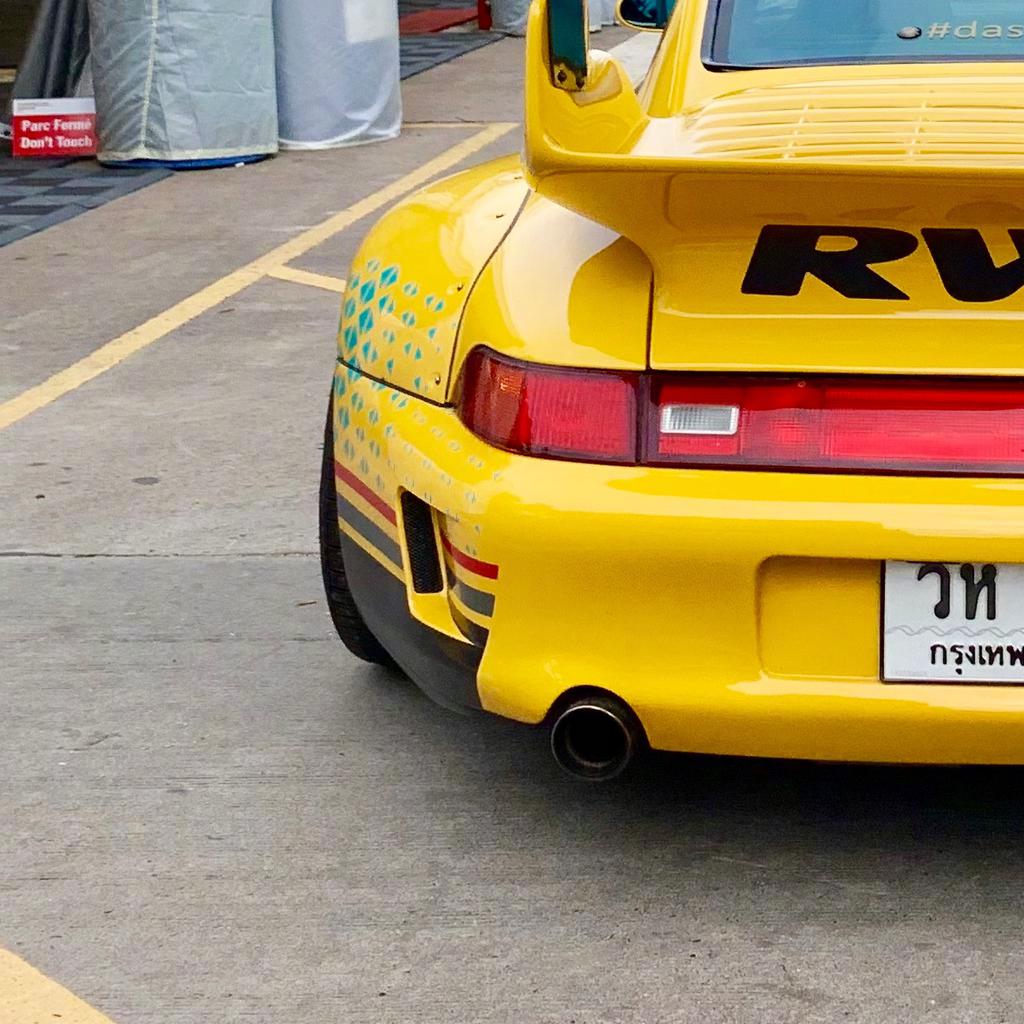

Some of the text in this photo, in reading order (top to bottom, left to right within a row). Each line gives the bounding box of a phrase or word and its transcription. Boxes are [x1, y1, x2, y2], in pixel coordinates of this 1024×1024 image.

[21, 120, 50, 132] Parc
[20, 136, 93, 149] Don't Touch
